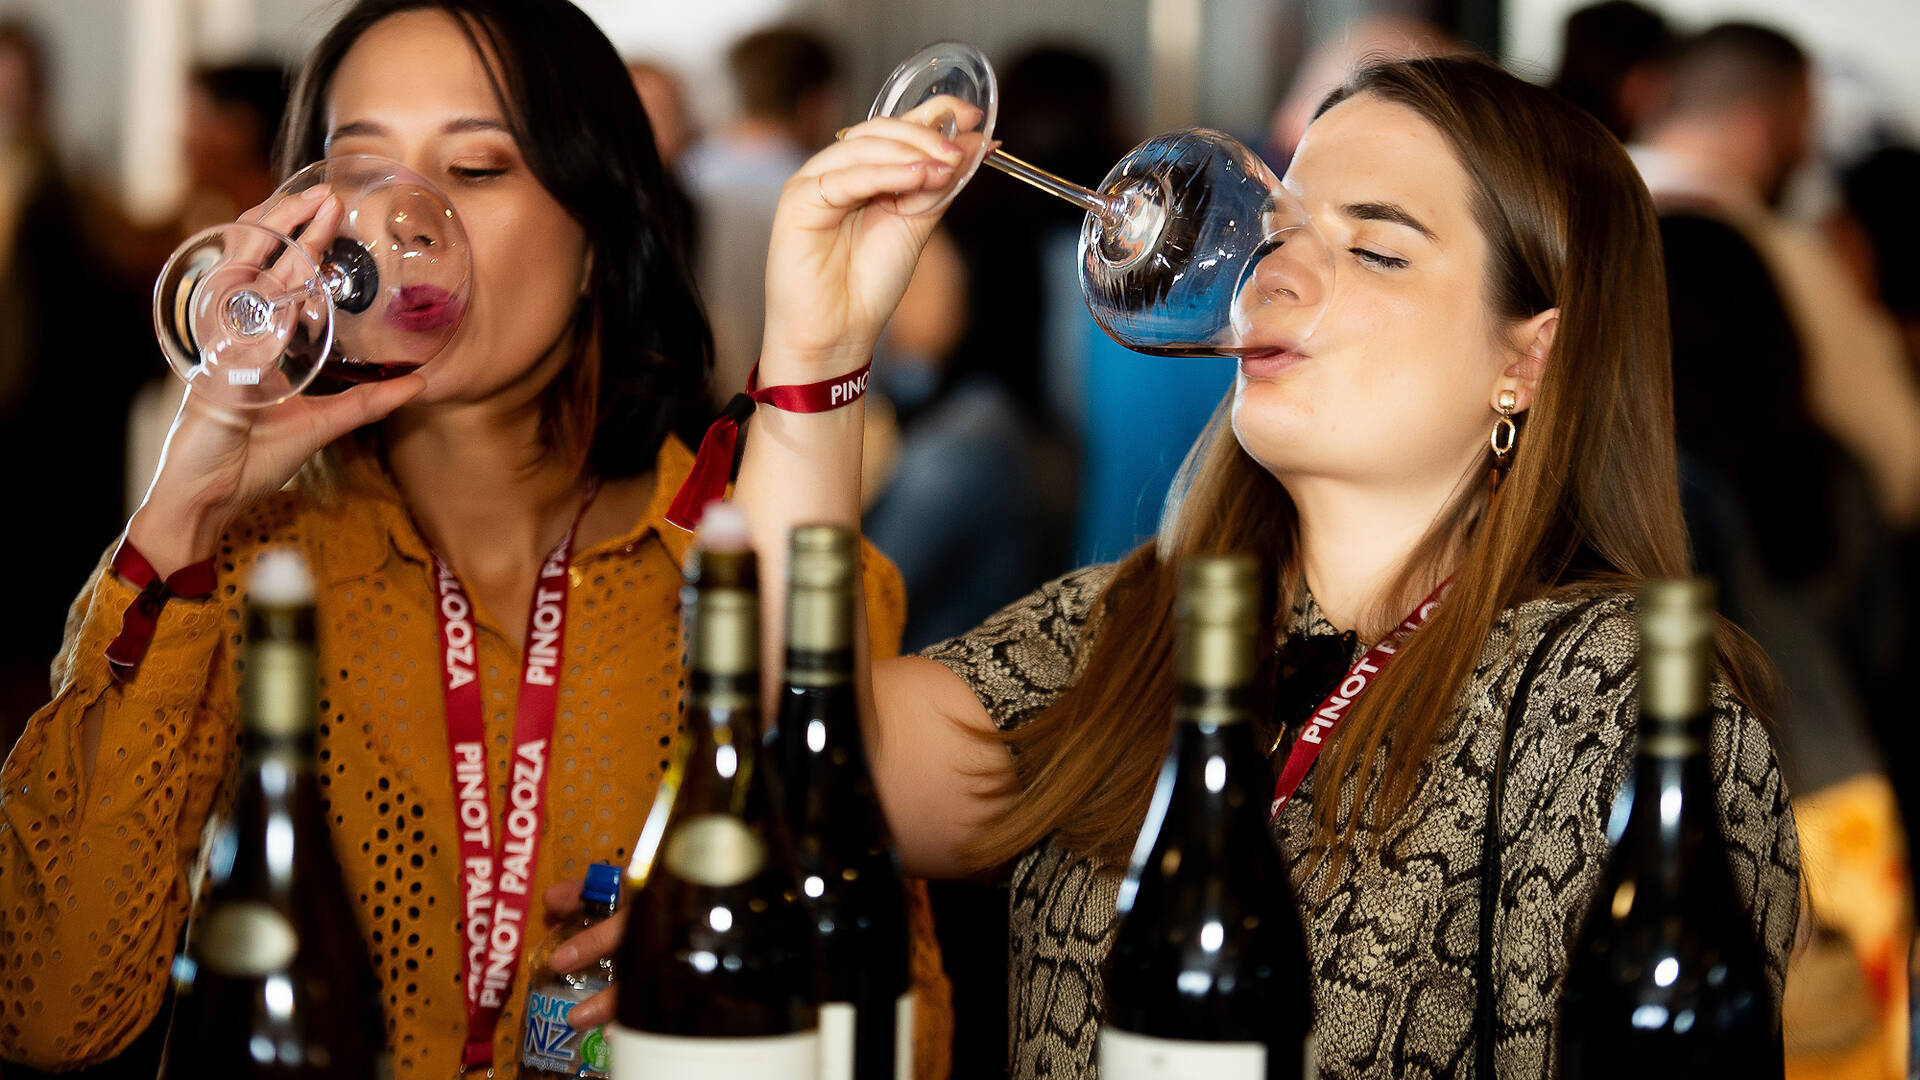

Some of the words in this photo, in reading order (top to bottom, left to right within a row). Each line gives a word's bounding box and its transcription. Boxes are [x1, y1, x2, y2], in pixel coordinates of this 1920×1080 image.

[831, 368, 871, 405] PINO
[437, 556, 476, 691] ALOOZA
[526, 588, 563, 686] PINOT
[1302, 657, 1380, 745] PINOT
[454, 741, 489, 850] PINOT
[500, 738, 546, 895] PALOOZA
[465, 857, 493, 1006] PALOO
[479, 899, 523, 1009] PINOT
[523, 1015, 576, 1060] NZ
